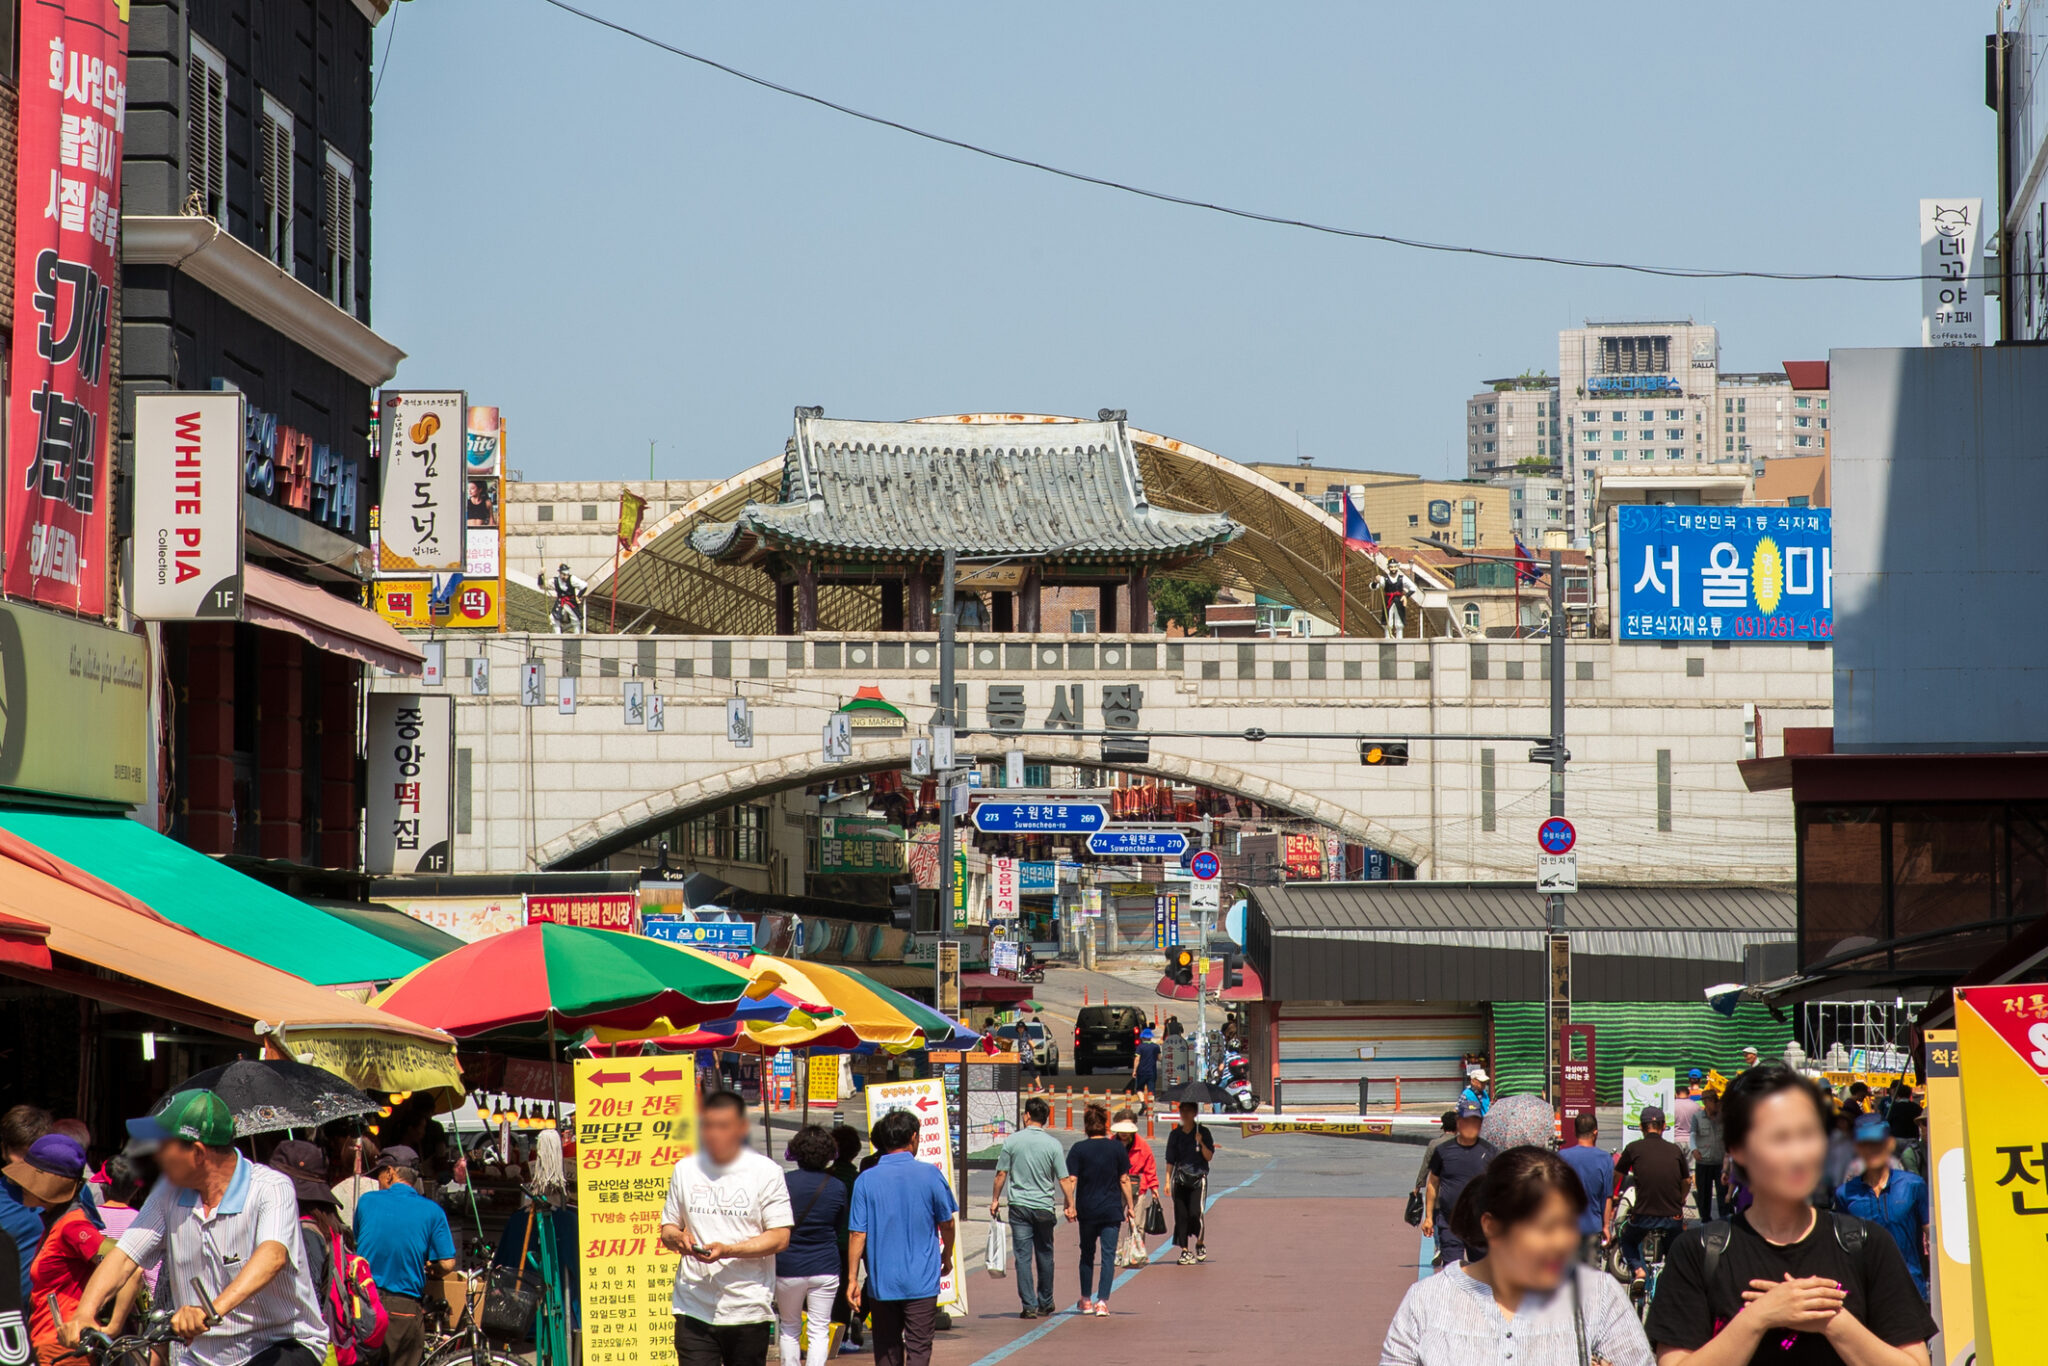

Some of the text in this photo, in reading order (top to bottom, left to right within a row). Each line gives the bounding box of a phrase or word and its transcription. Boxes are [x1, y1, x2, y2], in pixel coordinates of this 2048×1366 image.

[1935, 311, 1972, 323] 카페
[1691, 361, 1715, 369] HALLA
[175, 411, 201, 585] WHITE PIA
[1679, 515, 1819, 531] 대한민국 1등 식자재
[157, 527, 167, 586] Collection
[1633, 541, 1749, 608] 서울
[214, 590, 234, 608] 1F
[1627, 615, 1723, 637] 전문식자재유통
[868, 718, 903, 726] MARKET
[393, 707, 425, 851] 중앙떡집
[984, 813, 999, 822] 273
[1012, 805, 1069, 820] 수원천로
[1080, 814, 1095, 823] 269
[1014, 820, 1067, 830] Suwoncheon-ro
[1093, 839, 1107, 848] 274
[1119, 834, 1157, 845] 수원천로
[1167, 839, 1182, 848] 270
[822, 839, 842, 866] 남문
[843, 839, 874, 867] 축산물
[1110, 844, 1165, 853] Suwoncheon-ro
[428, 855, 444, 870] 1F
[1540, 856, 1575, 865] 견인지역
[1021, 865, 1053, 884] 인테리어
[571, 902, 600, 926] 박람회
[602, 901, 631, 926] 전시장
[652, 928, 748, 941] 서울 마트
[1565, 1073, 1590, 1081] 내리는 곳
[586, 1094, 683, 1118] 20년 전통
[579, 1121, 643, 1145] 팔달문
[582, 1147, 642, 1170] 정직과
[587, 1177, 665, 1191] 금산인삼 생산지
[598, 1191, 621, 1203] 토종
[622, 1190, 655, 1203] 한국산
[689, 1184, 751, 1208] FILA
[688, 1206, 749, 1217] BIELLA ITALIA
[591, 1212, 626, 1224] TV방송
[632, 1223, 654, 1235] 허가
[585, 1238, 647, 1259] 최저가
[588, 1265, 636, 1277] 보이차
[588, 1279, 636, 1290] 사차인치
[589, 1294, 637, 1305] 브라질너트
[589, 1308, 637, 1320] 와일드망고
[590, 1352, 638, 1363] 아로니아
